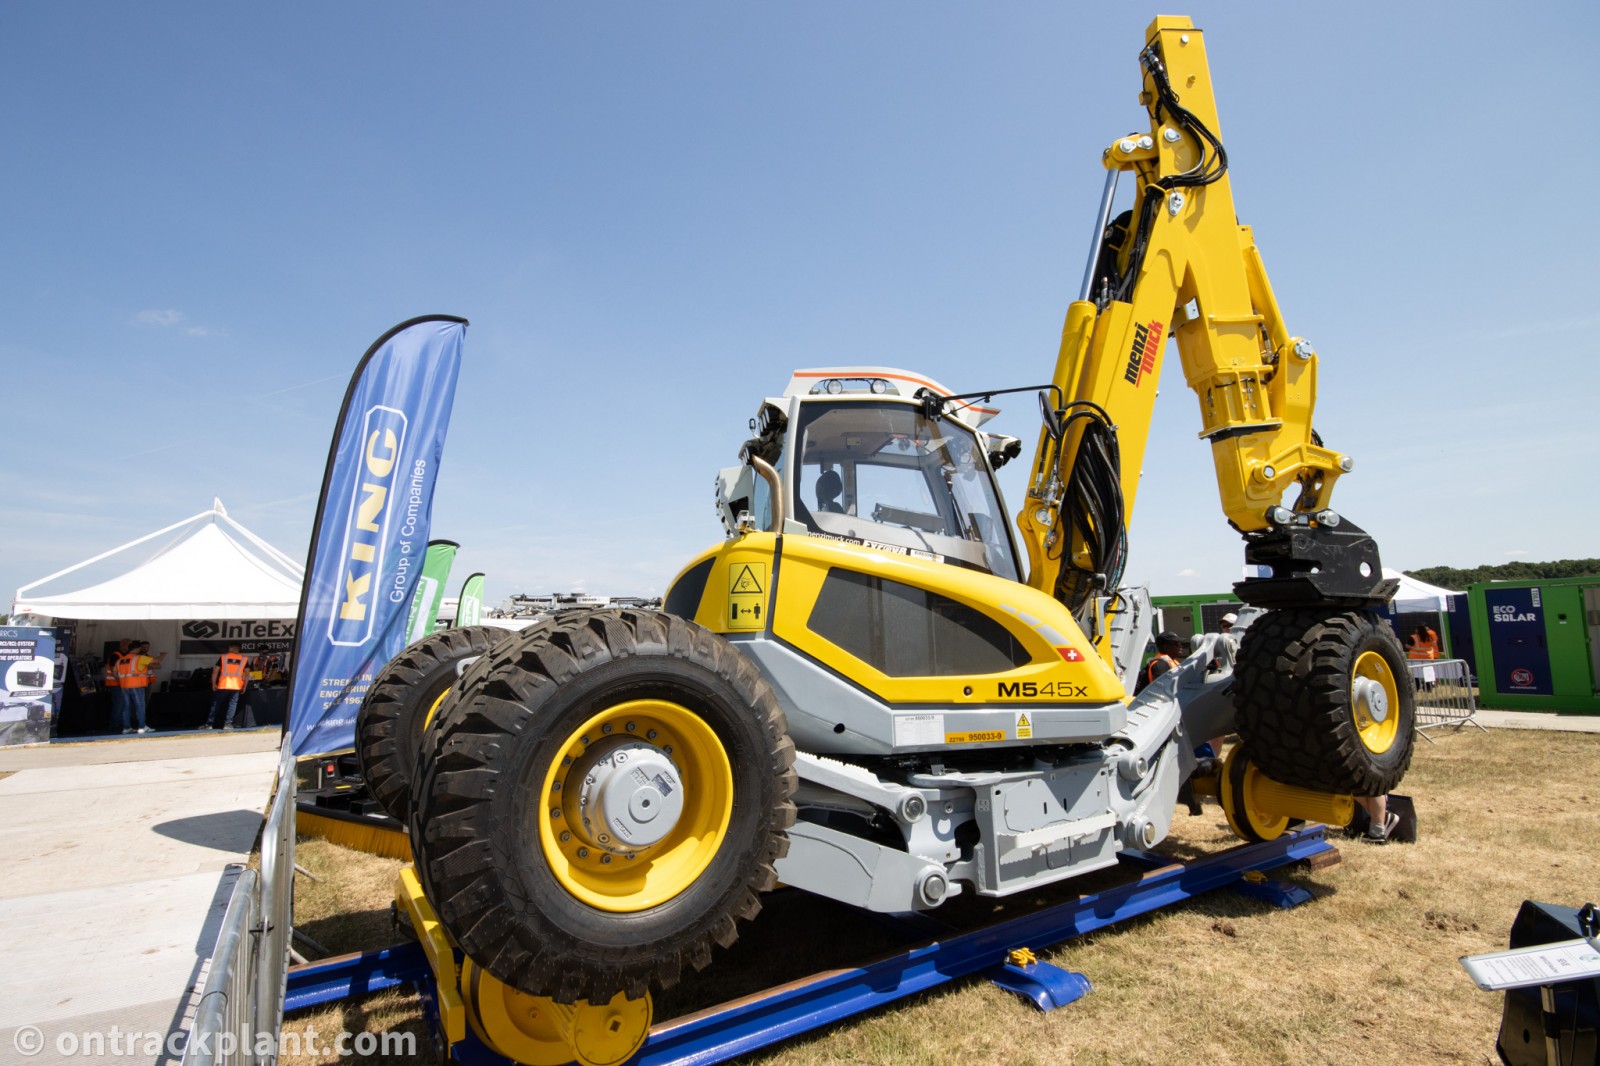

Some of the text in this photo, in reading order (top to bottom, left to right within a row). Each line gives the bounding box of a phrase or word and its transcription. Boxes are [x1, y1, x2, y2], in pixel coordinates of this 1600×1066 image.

[1124, 322, 1149, 385] menzi
[1136, 320, 1163, 388] muck
[340, 428, 397, 621] KING
[389, 459, 426, 602] Group of Companies
[1492, 605, 1516, 614] ECO
[1494, 613, 1537, 622] SOLAR
[221, 620, 294, 638] InTeEx
[257, 642, 290, 650] SSTEM
[362, 673, 372, 682] IN
[998, 682, 1088, 698] M545x
[968, 732, 1002, 741] 950033-9
